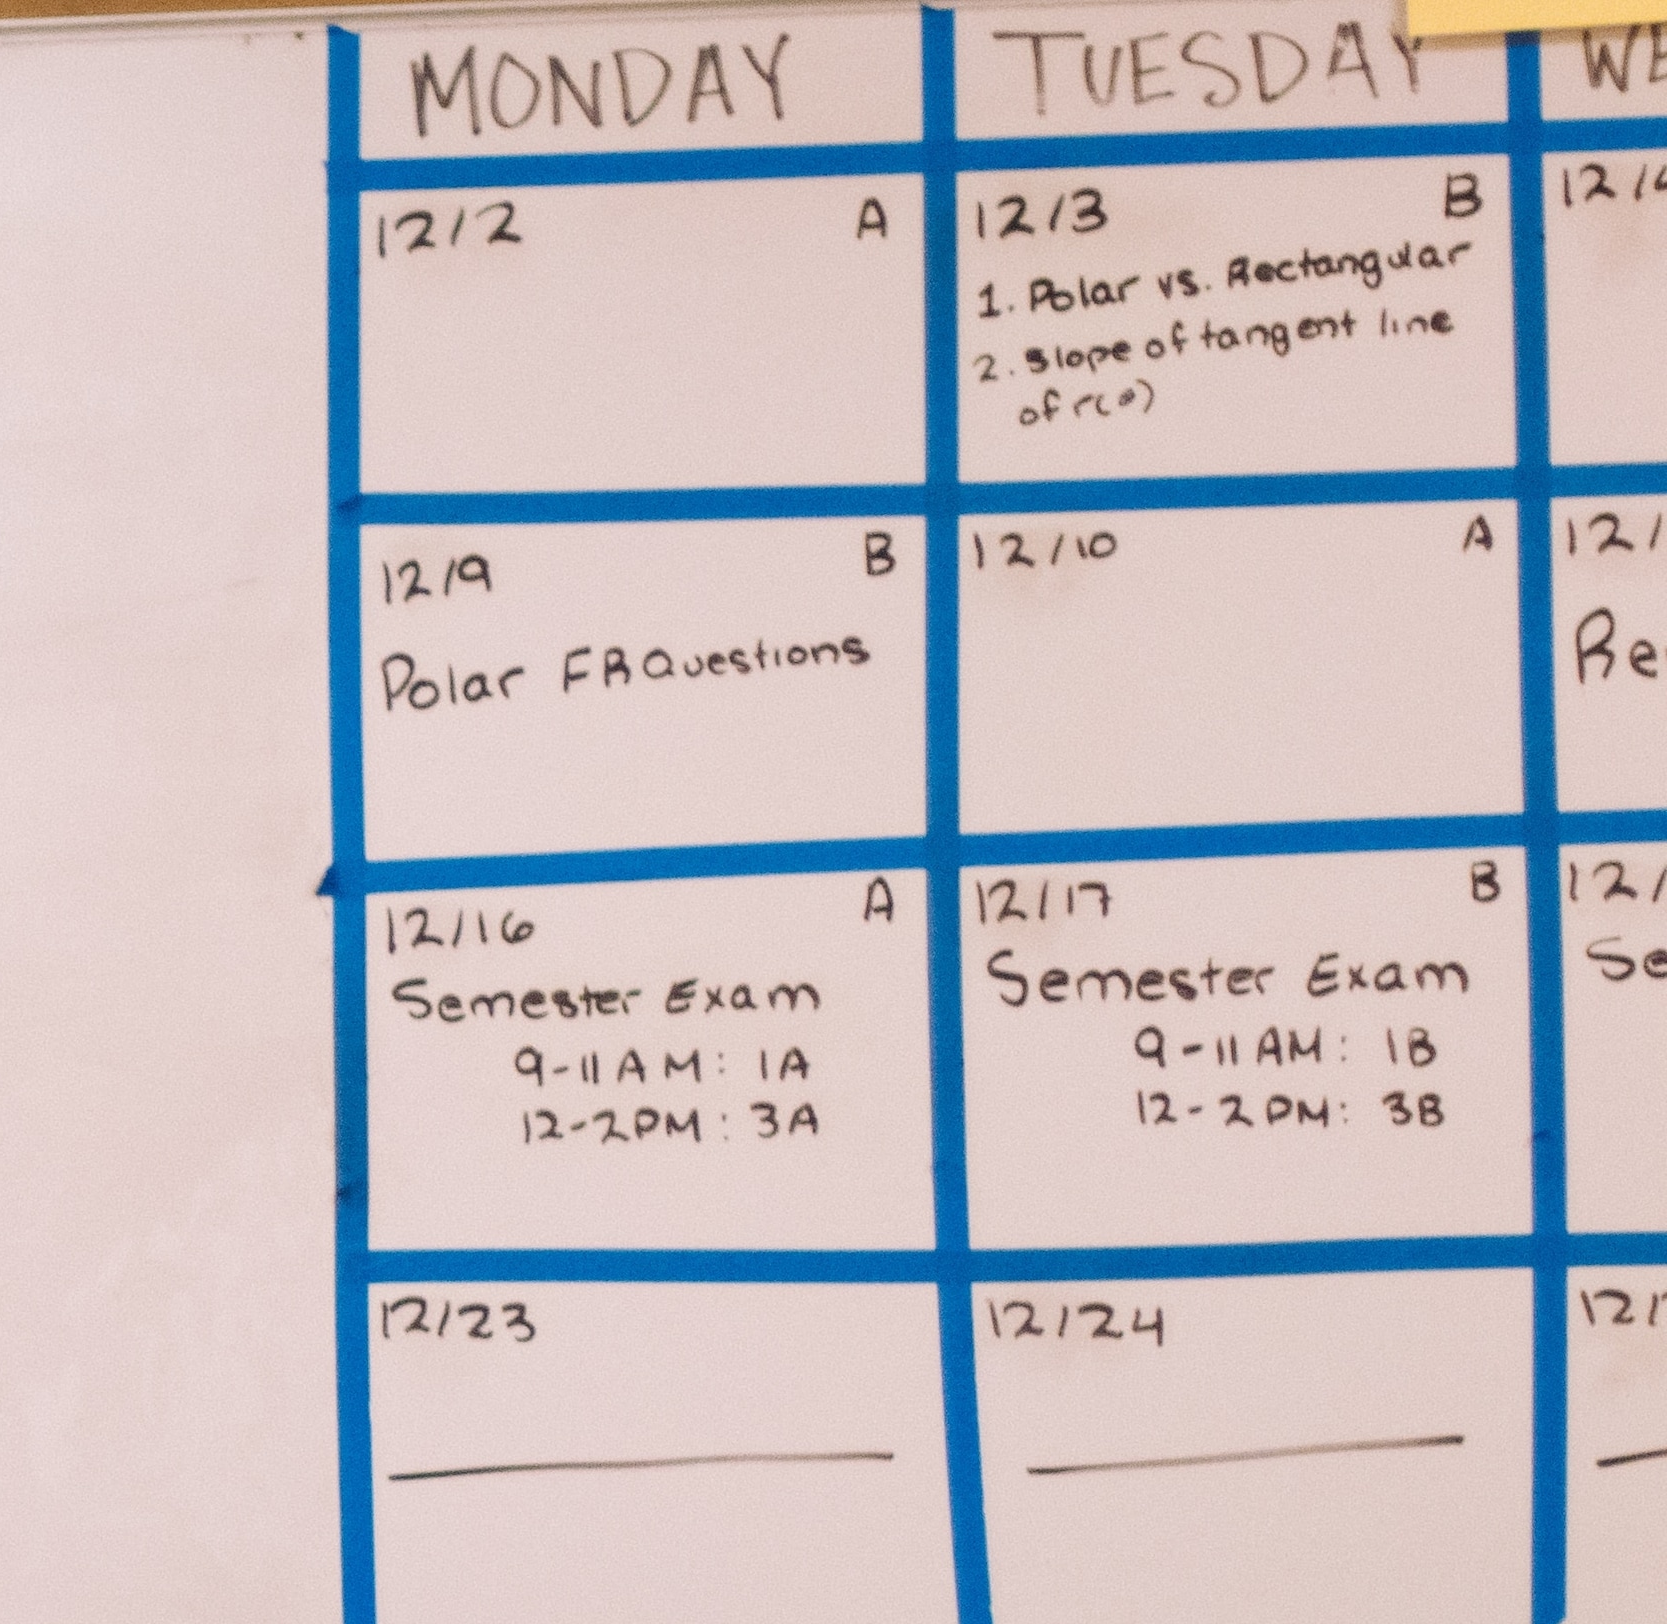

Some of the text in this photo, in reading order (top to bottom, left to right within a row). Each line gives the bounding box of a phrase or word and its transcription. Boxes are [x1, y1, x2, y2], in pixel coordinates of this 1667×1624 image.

[410, 33, 790, 138] MONDAY
[992, 21, 1423, 115] TUESDAY
[856, 197, 888, 239] A
[977, 187, 1109, 239] 12/3
[1443, 172, 1483, 219] B
[378, 200, 523, 258] 12/2
[978, 241, 1472, 319] 1. Polar vs. Rectangular
[974, 353, 1014, 384] 2.
[1144, 320, 1188, 360] of
[1200, 310, 1357, 358] tangent
[1380, 309, 1454, 337] line
[1018, 387, 1061, 426] of
[864, 530, 897, 577] B
[973, 531, 1117, 570] 12/10
[1462, 514, 1494, 551] A
[383, 553, 492, 604] 12/9
[1574, 606, 1667, 685] Re
[380, 652, 525, 712] Polar
[864, 876, 896, 923] A
[976, 878, 1112, 924] 12/17
[1470, 860, 1501, 904] B
[387, 906, 535, 955] 12/16
[391, 977, 821, 1024] Semester Exam
[986, 948, 1470, 1008] Semester Exam
[760, 1046, 810, 1081] 1A
[1386, 1027, 1437, 1068] 1B
[750, 1101, 819, 1139] 3A
[1381, 1090, 1445, 1128] 3B
[381, 1295, 536, 1343] 12/23
[989, 1300, 1164, 1347] 12/24
[1580, 1288, 1667, 1327] 12/
